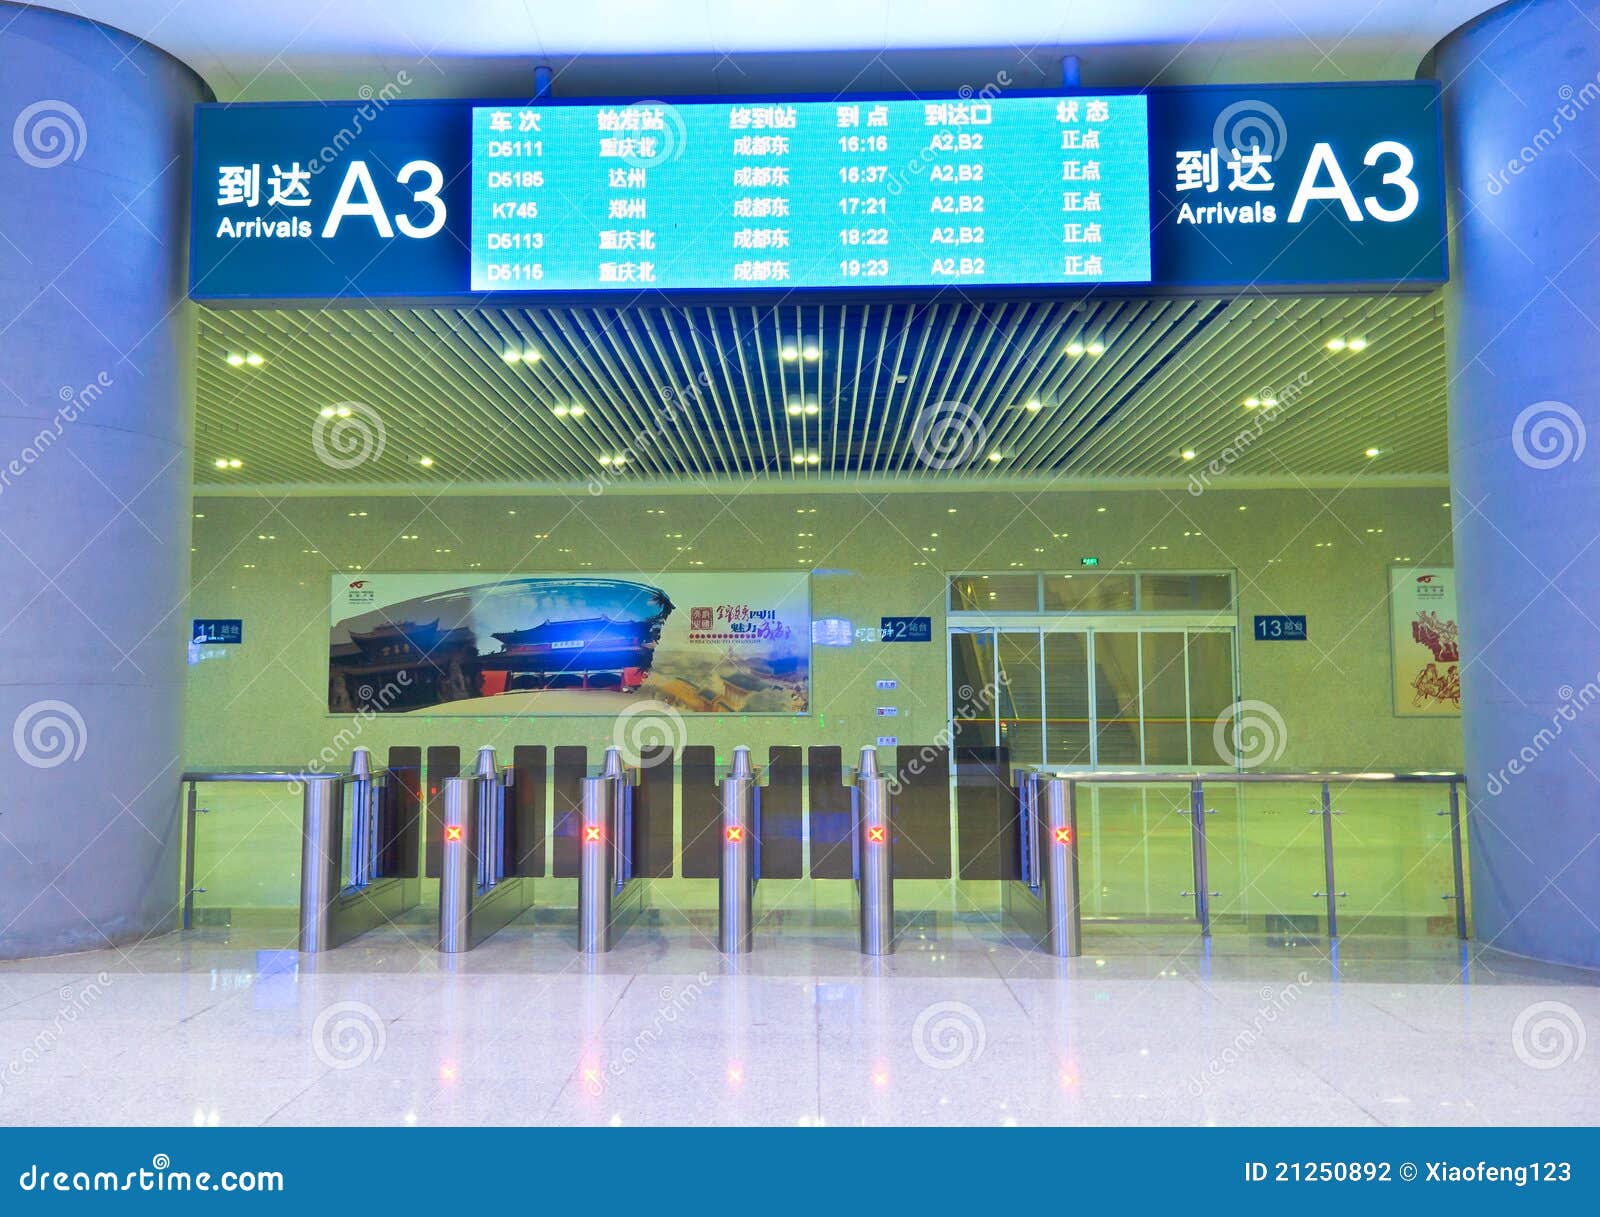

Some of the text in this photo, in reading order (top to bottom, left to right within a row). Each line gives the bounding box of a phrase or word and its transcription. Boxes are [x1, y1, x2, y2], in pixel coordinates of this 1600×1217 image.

[489, 100, 1110, 132] 车次 始发站 终到站 到点 到达口 状态
[488, 129, 1100, 157] D5111 重庆北 成都东 16:16 A2,B2 正点
[608, 168, 647, 188] 达州
[733, 167, 789, 187] 成都东
[839, 166, 888, 183] 16:37
[930, 165, 984, 184] A2,B2
[1062, 160, 1101, 181] 正点
[1175, 147, 1275, 194] 到达
[1287, 140, 1420, 224] A3
[216, 163, 312, 208] 到达
[321, 159, 448, 239] A3
[493, 191, 1102, 219] K745 郑州 成都东 17:21 A2,B2 正点
[1176, 201, 1277, 225] Arrivals
[216, 217, 312, 239] Arrivals
[599, 230, 656, 250] 重庆北
[733, 228, 789, 249] 成都东
[839, 229, 888, 246] 18:22
[930, 227, 984, 246] A2,B2
[1063, 222, 1102, 244] 正点
[599, 262, 656, 283] 重庆北
[733, 260, 790, 281] 成都东
[840, 259, 889, 277] 19:23
[931, 258, 985, 277] A2,B2
[1064, 255, 1103, 276] 正点
[1259, 620, 1282, 636] 13
